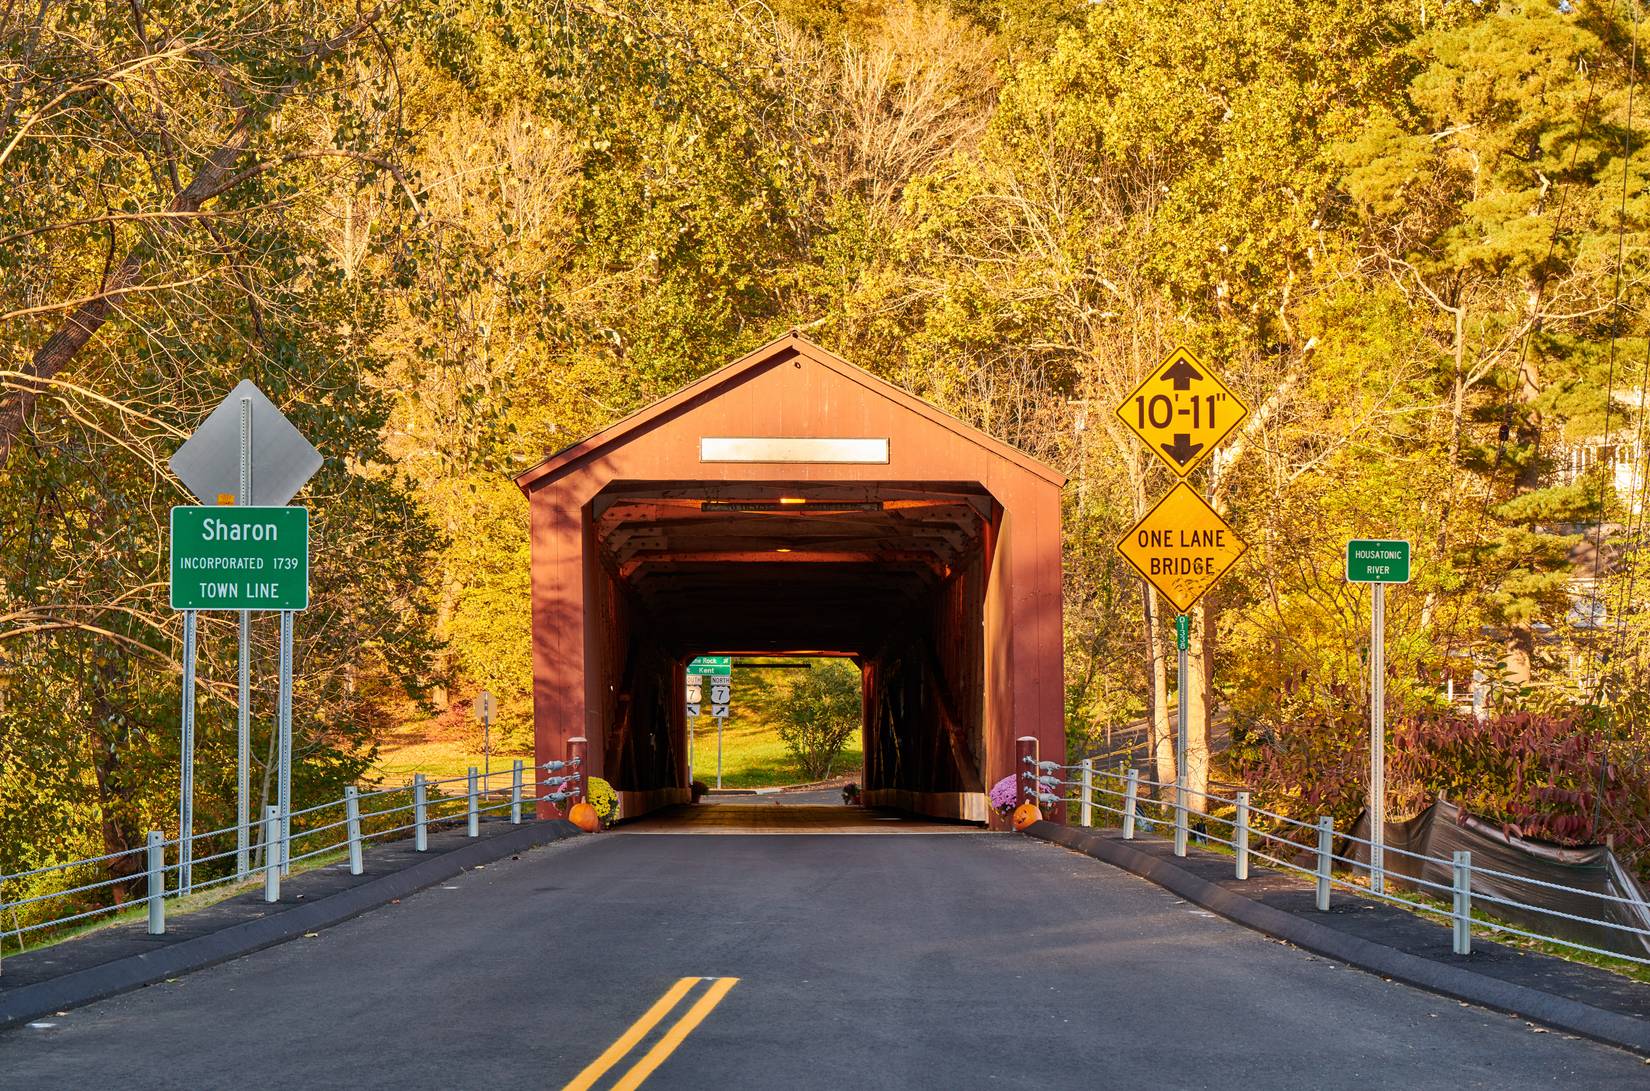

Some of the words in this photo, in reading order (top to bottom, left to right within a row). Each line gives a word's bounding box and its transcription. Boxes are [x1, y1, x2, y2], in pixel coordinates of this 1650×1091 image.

[1135, 392, 1226, 429] 10'-11"
[202, 518, 278, 541] Sharon
[1138, 529, 1173, 548] ONE
[1180, 529, 1226, 548] LANE
[1355, 550, 1402, 560] HOUSATONIC
[180, 557, 264, 570] INCORPORATED
[273, 557, 299, 570] 1739
[1150, 557, 1215, 575] BRIDGE
[1366, 566, 1390, 574] RIVER
[199, 582, 238, 599] TOWN
[246, 582, 279, 599] LINE
[690, 690, 695, 700] 7
[718, 690, 724, 700] 7
